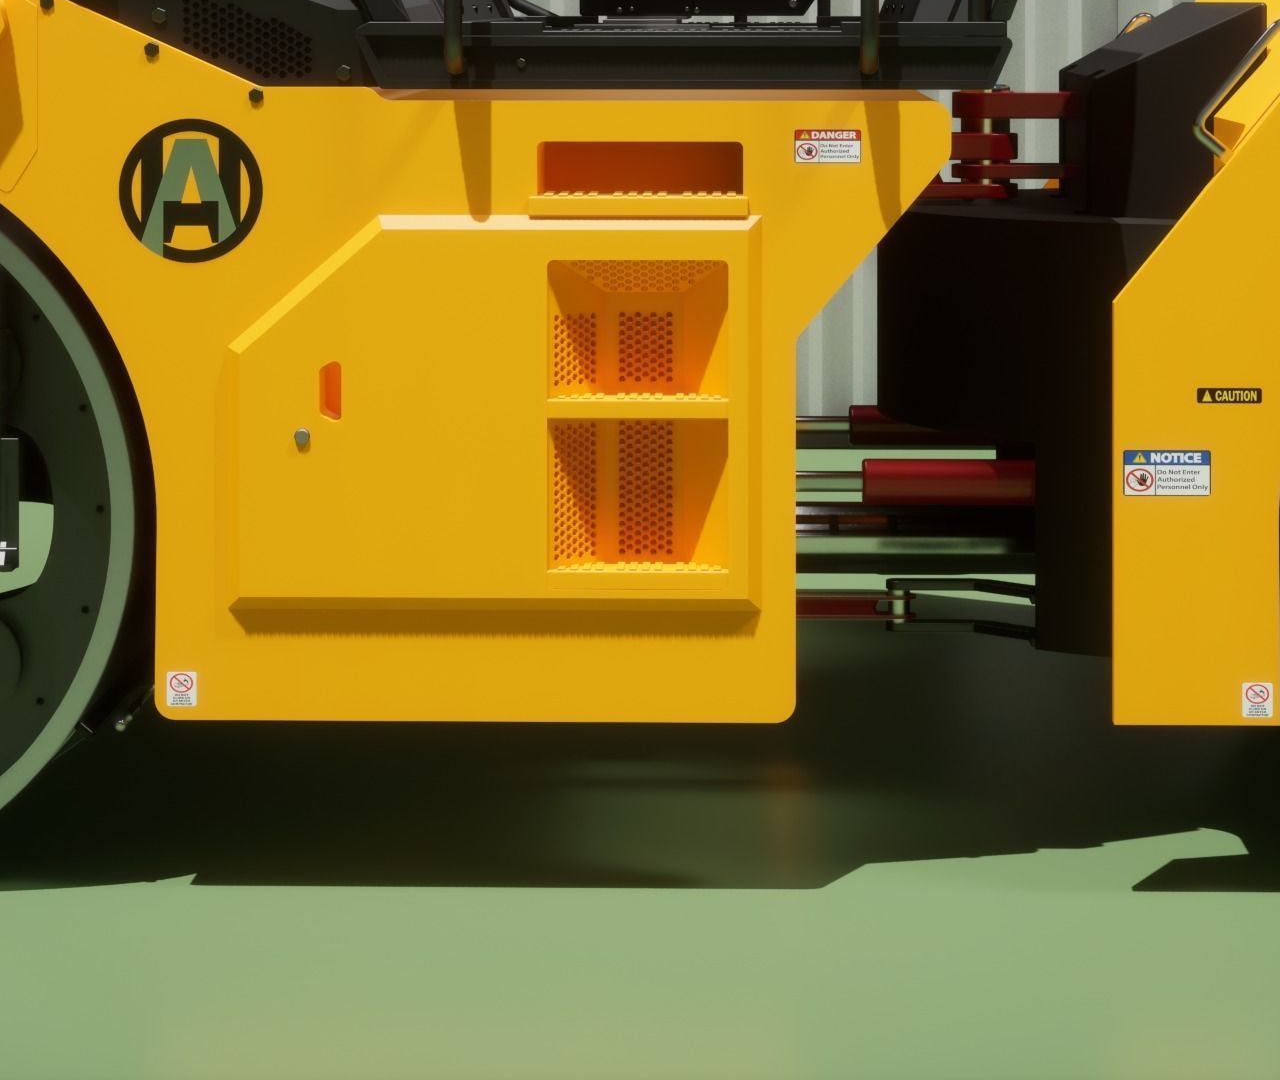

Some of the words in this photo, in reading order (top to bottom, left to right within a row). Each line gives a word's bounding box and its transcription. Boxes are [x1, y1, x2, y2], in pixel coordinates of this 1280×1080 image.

[811, 131, 857, 139] DANGER
[1214, 390, 1258, 402] CAUTION
[1150, 452, 1202, 463] NOTICE
